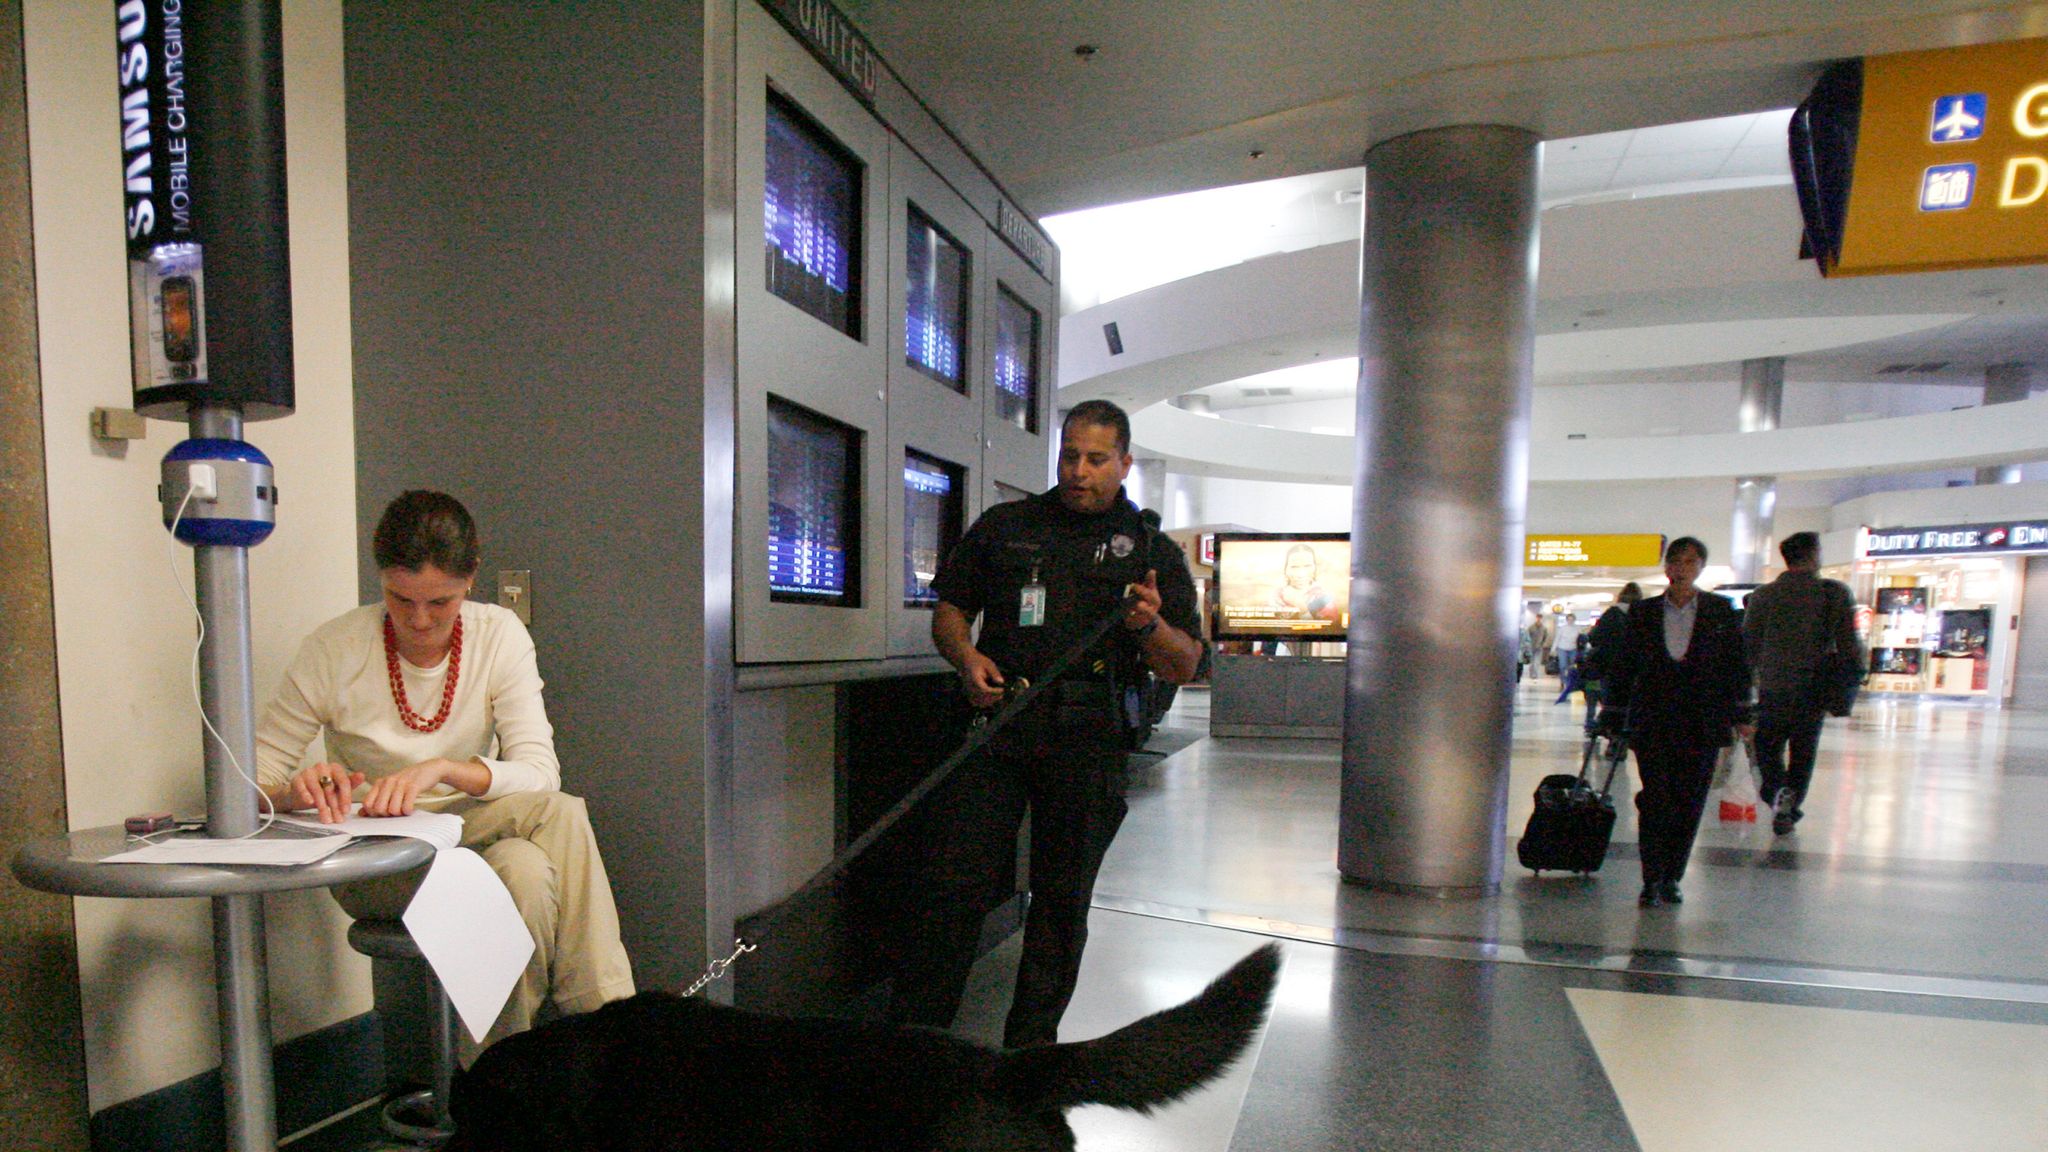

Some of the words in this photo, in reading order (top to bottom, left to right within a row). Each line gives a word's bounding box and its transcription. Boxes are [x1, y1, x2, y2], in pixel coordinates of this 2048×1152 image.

[163, 0, 187, 131] CHARGING
[799, 0, 875, 94] UNITED
[168, 136, 190, 231] MOBILE
[1868, 534, 1919, 551] DUTY
[1921, 531, 1978, 549] FREE
